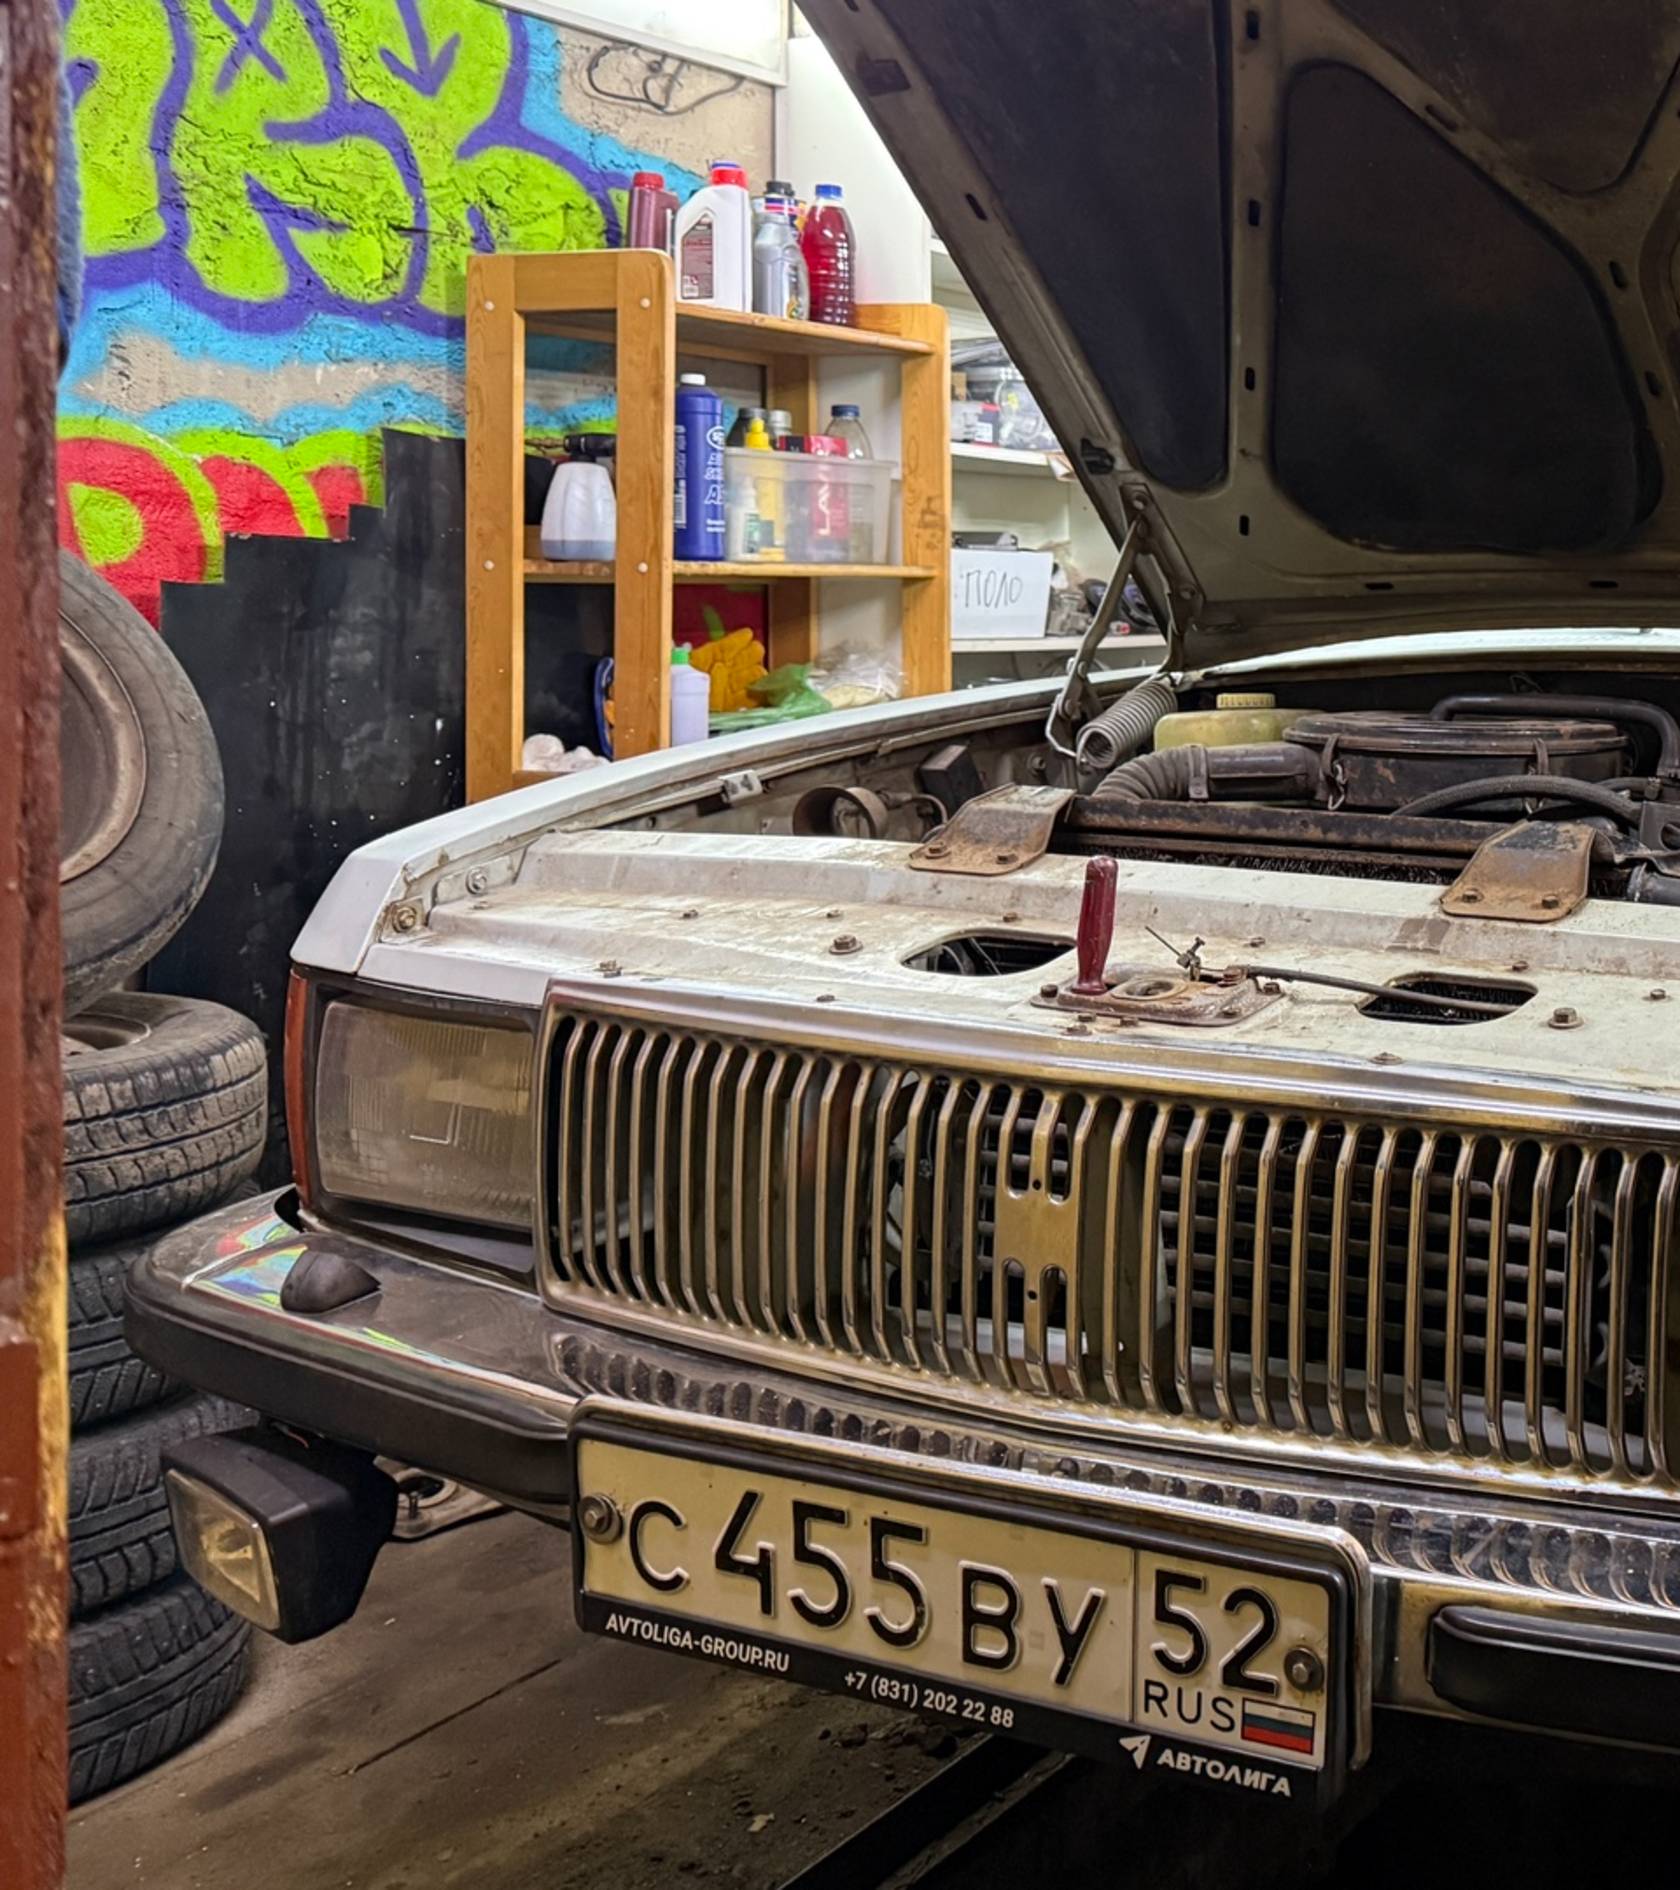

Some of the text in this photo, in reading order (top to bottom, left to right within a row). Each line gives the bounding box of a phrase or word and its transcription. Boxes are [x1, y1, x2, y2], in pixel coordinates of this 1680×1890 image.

[964, 569, 1024, 609] ПОЛО
[605, 1613, 790, 1673] AVTOLIGA-GROUP.RU
[1152, 1569, 1279, 1696] 52
[844, 1671, 1014, 1728] +7 (831) 202 22 88
[1144, 1679, 1235, 1733] RUS
[1157, 1748, 1292, 1798] АВТОЛИГА
